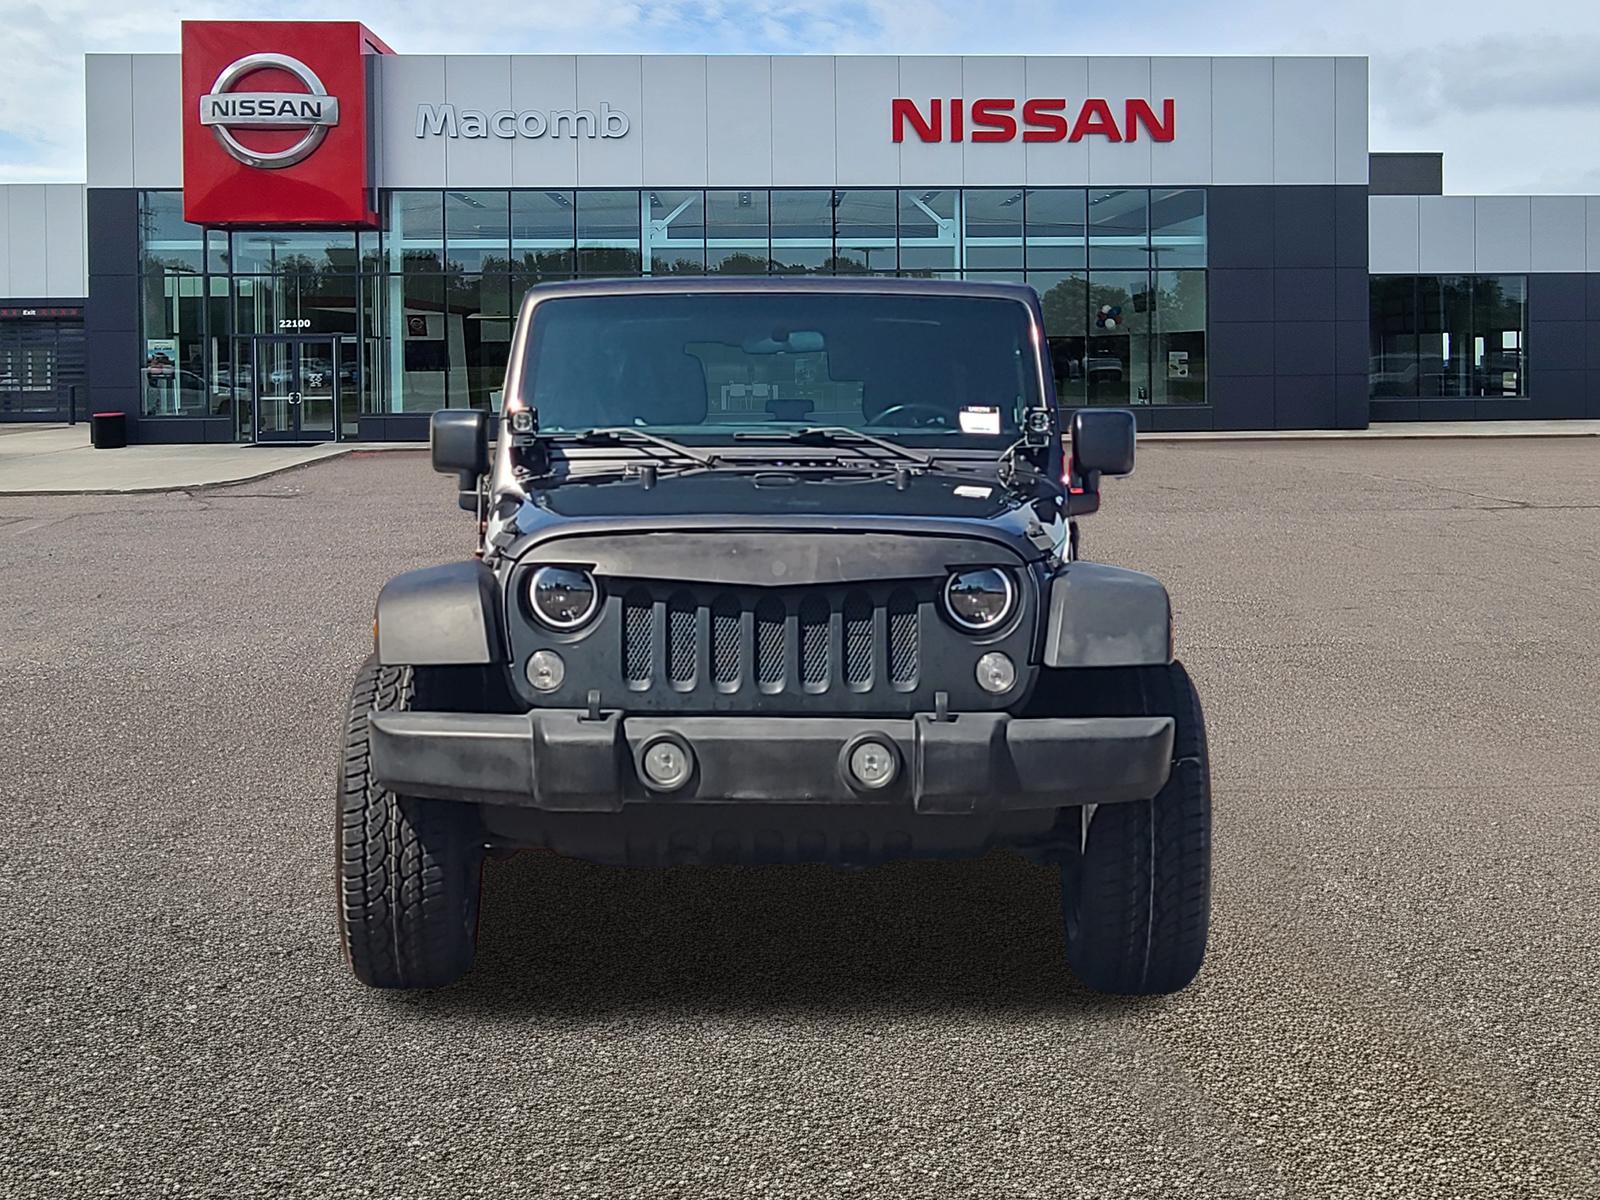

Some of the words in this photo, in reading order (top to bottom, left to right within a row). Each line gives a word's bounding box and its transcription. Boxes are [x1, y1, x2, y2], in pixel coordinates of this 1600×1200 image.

[212, 100, 322, 118] NISSAN
[415, 101, 631, 139] Macomb
[892, 98, 1175, 143] NISSAN
[279, 319, 311, 328] 22100
